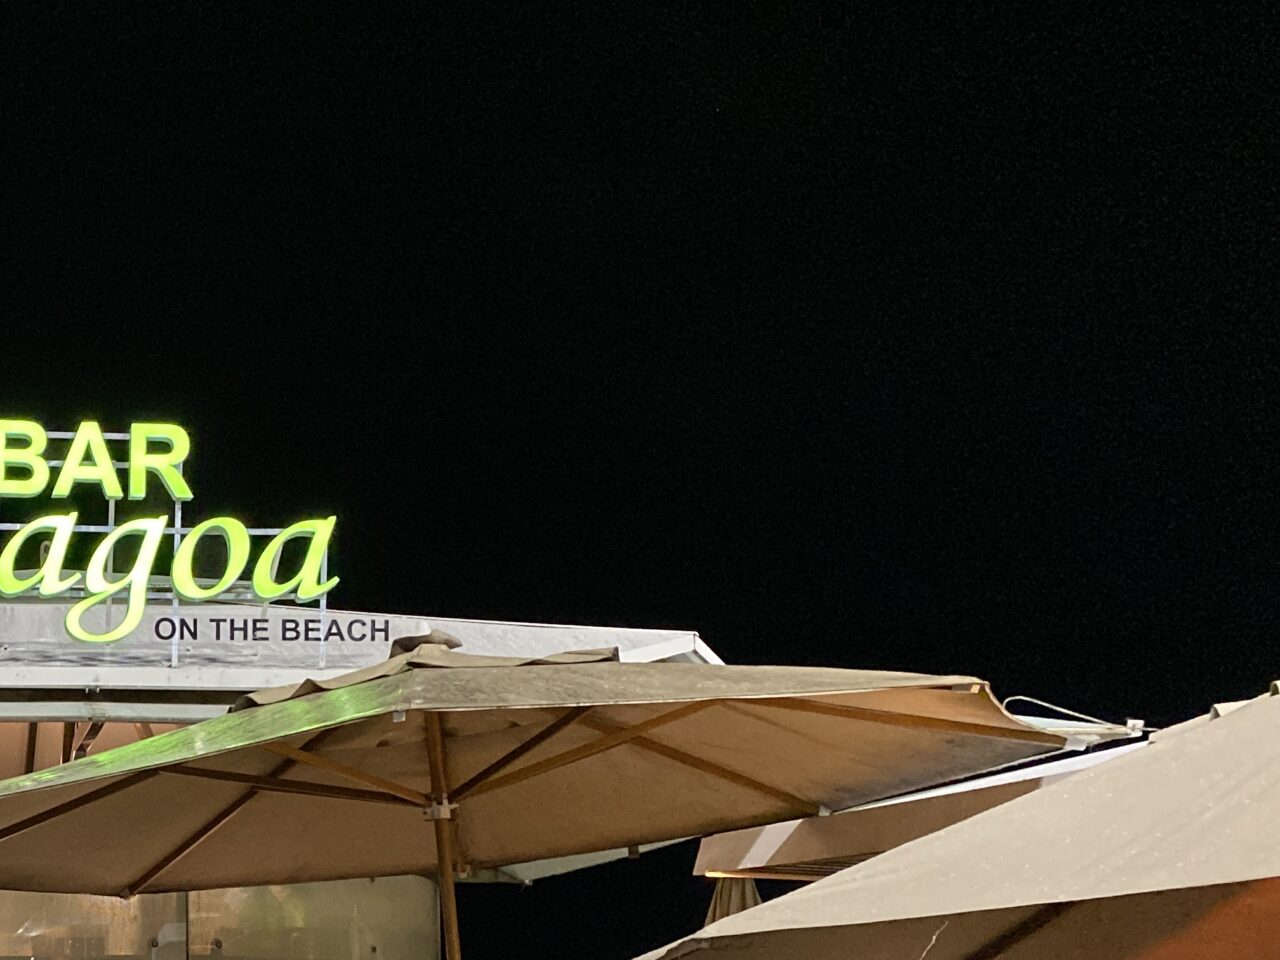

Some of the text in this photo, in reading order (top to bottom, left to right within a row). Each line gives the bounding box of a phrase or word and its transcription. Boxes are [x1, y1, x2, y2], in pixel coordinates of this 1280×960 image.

[154, 617, 390, 642] ON THE BEACH
